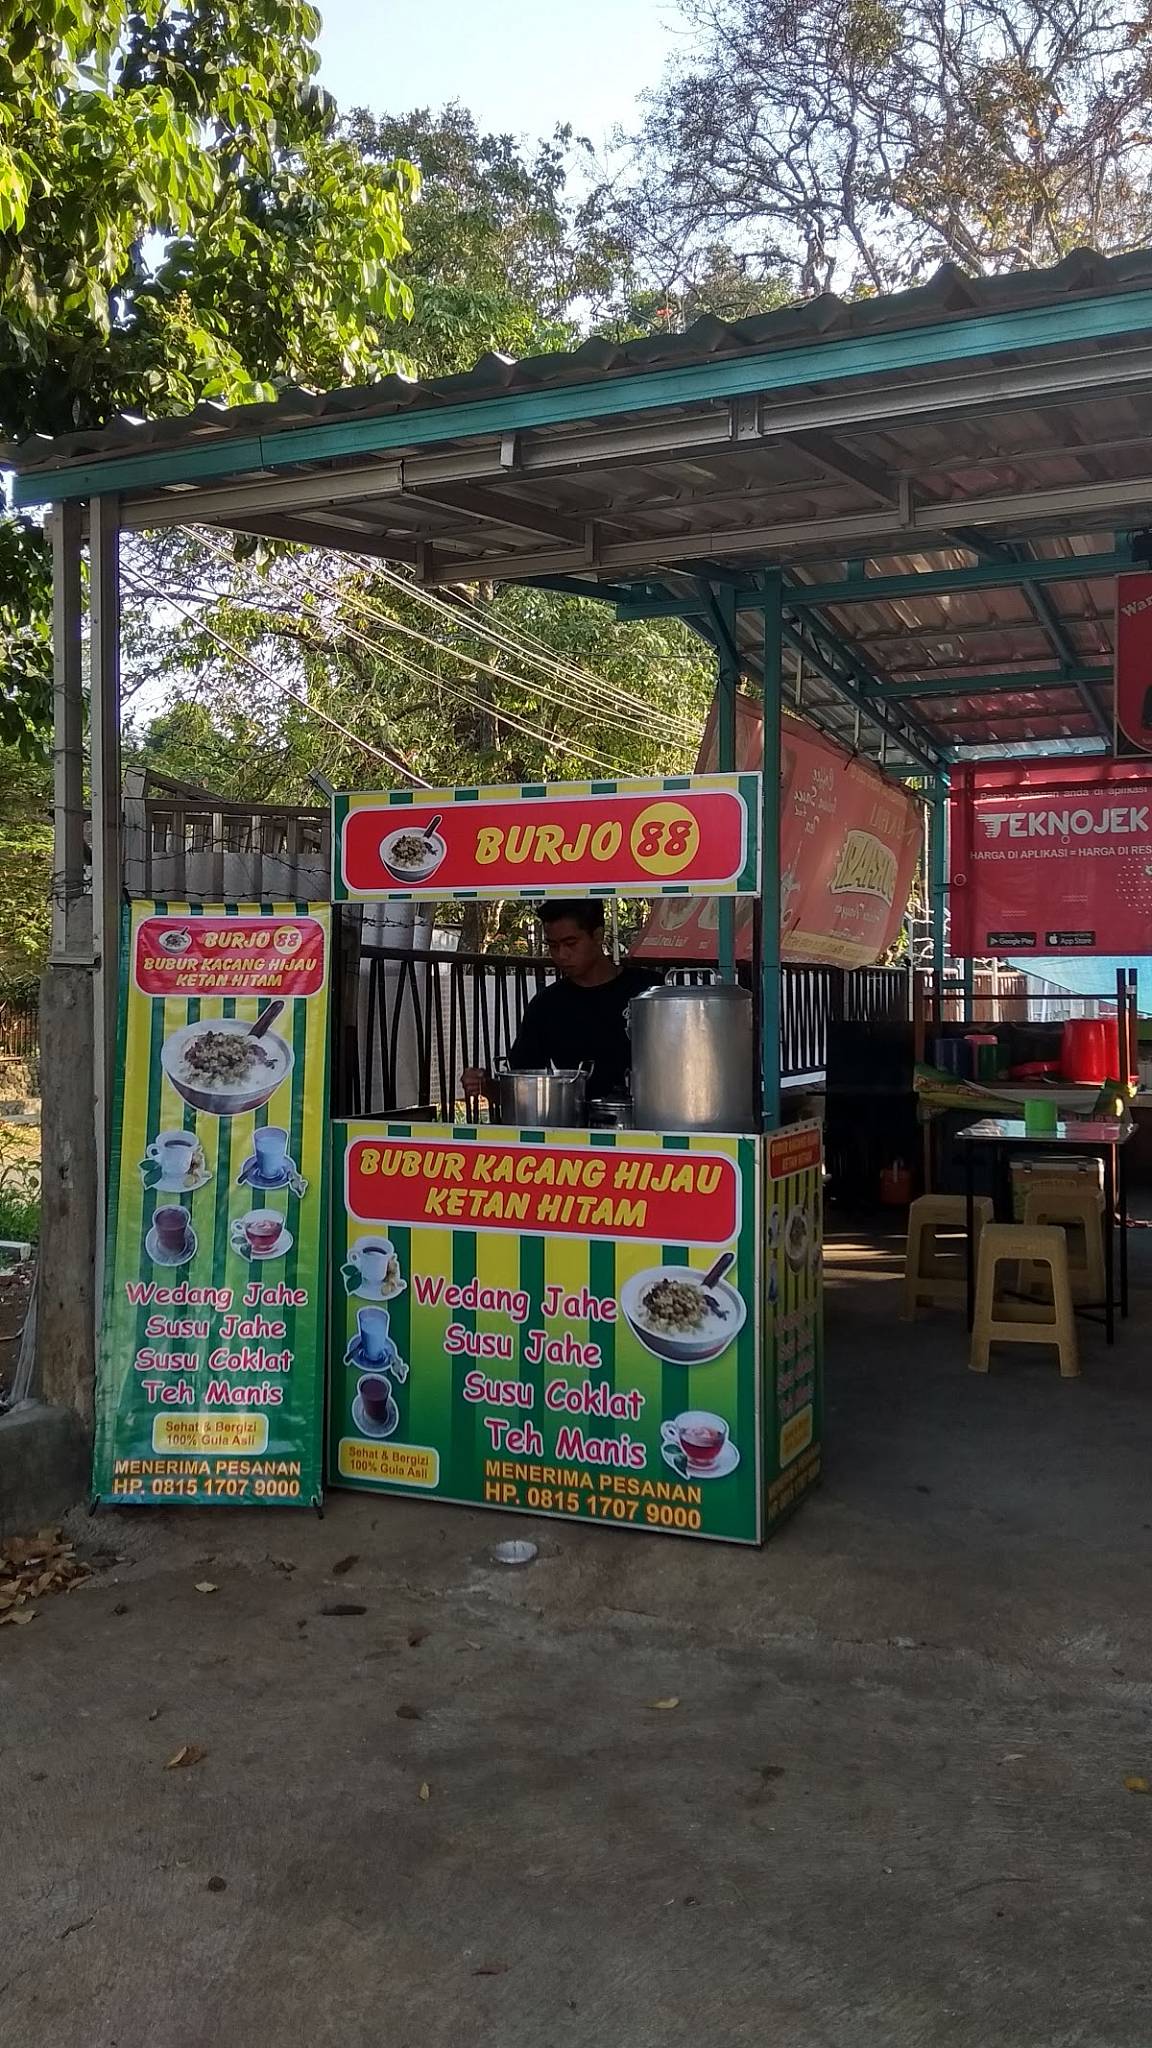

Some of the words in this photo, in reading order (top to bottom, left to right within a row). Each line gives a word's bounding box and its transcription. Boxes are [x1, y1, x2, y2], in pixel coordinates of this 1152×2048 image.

[1064, 787, 1089, 797] anda
[1094, 787, 1103, 796] di
[1108, 785, 1147, 797] aplikasi
[976, 807, 1149, 838] TEKNOJEK
[475, 821, 622, 865] BURJO
[636, 819, 692, 858] 88
[970, 850, 1005, 861] HARGA
[1008, 850, 1018, 859] DI
[1020, 848, 1068, 859] APLIKASI
[1078, 846, 1115, 857] HARGA
[1118, 846, 1129, 855] DI
[204, 932, 270, 949] BURJO
[275, 933, 299, 948] 88
[143, 957, 199, 971] BUBUR
[201, 958, 265, 972] KACANG
[268, 958, 317, 971] HIJAU
[176, 974, 229, 987] KETAN
[231, 974, 283, 987] HITAM
[359, 1148, 465, 1183] BUBUR
[472, 1153, 607, 1189] KACANG
[613, 1161, 723, 1195] HIJAU
[424, 1187, 530, 1220] KETAN
[537, 1194, 648, 1228] HITAM
[126, 1281, 233, 1311] Wedang
[243, 1281, 308, 1307] Jahe
[413, 1275, 530, 1322] Wedang
[542, 1286, 618, 1323] Jahe
[145, 1315, 209, 1339] Susu
[219, 1314, 286, 1339] Jahe
[444, 1323, 513, 1359] Susu
[525, 1330, 602, 1368] Jahe
[134, 1348, 199, 1372] Susu
[208, 1346, 294, 1372] Coklat
[141, 1379, 193, 1404] Teh
[204, 1380, 283, 1406] Manis
[463, 1372, 532, 1406] Susu
[546, 1380, 645, 1419] Coklat
[165, 1421, 199, 1432] Sehat
[215, 1421, 257, 1434] Bergizi
[167, 1434, 197, 1446] 100%
[201, 1434, 229, 1445] Gula
[232, 1435, 255, 1446] Asli
[349, 1447, 378, 1460] Sehat
[381, 1450, 389, 1461] &
[392, 1451, 429, 1466] Bergizi
[484, 1418, 542, 1457] Teh
[557, 1427, 647, 1469] Manis
[114, 1460, 210, 1475] MENERIMA
[216, 1461, 301, 1476] PESANAN
[350, 1460, 377, 1473] 100%
[380, 1462, 405, 1476] Gula
[406, 1465, 428, 1480] Asli
[113, 1479, 144, 1495] HP.
[152, 1479, 198, 1495] 0815
[204, 1479, 248, 1496] 1707
[254, 1480, 300, 1496] 9000
[485, 1460, 594, 1491] MENERIMA
[600, 1473, 701, 1504] PESANAN
[484, 1481, 519, 1505] HP.
[527, 1486, 579, 1512] 0815
[586, 1493, 637, 1521] 1707
[646, 1502, 702, 1529] 9000
